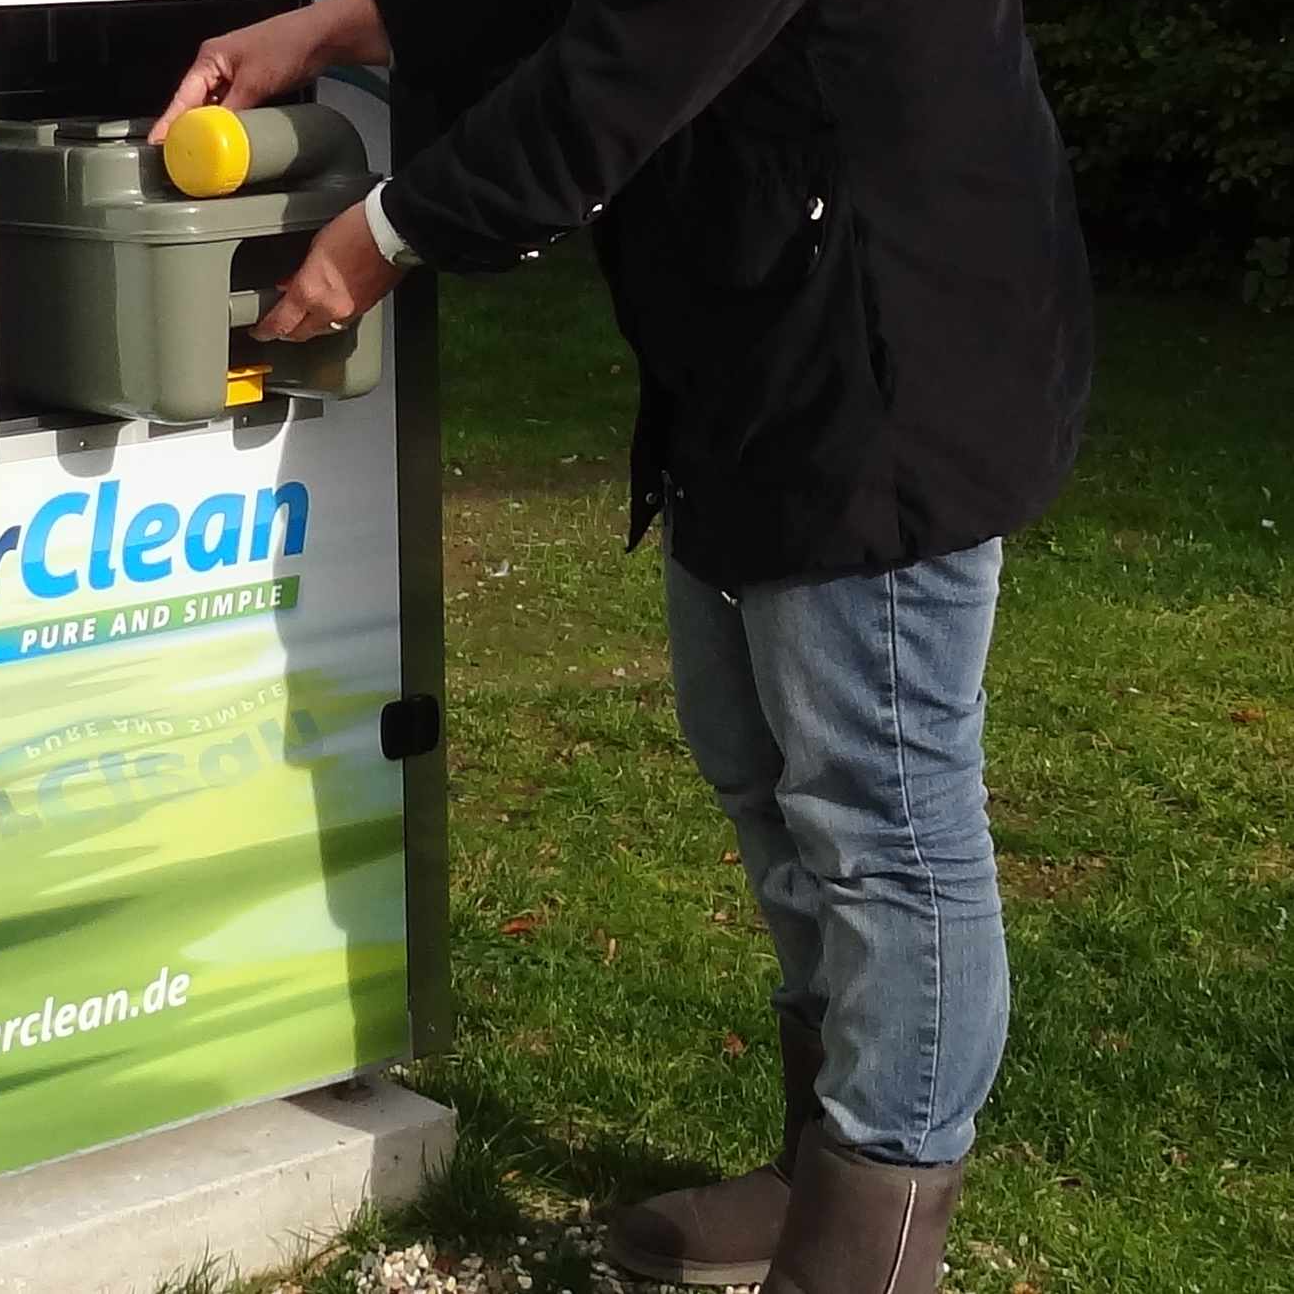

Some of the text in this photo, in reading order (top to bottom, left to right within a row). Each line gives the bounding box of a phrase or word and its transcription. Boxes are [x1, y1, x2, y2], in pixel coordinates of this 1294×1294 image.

[20, 584, 283, 654] PURE AND SIMPLE
